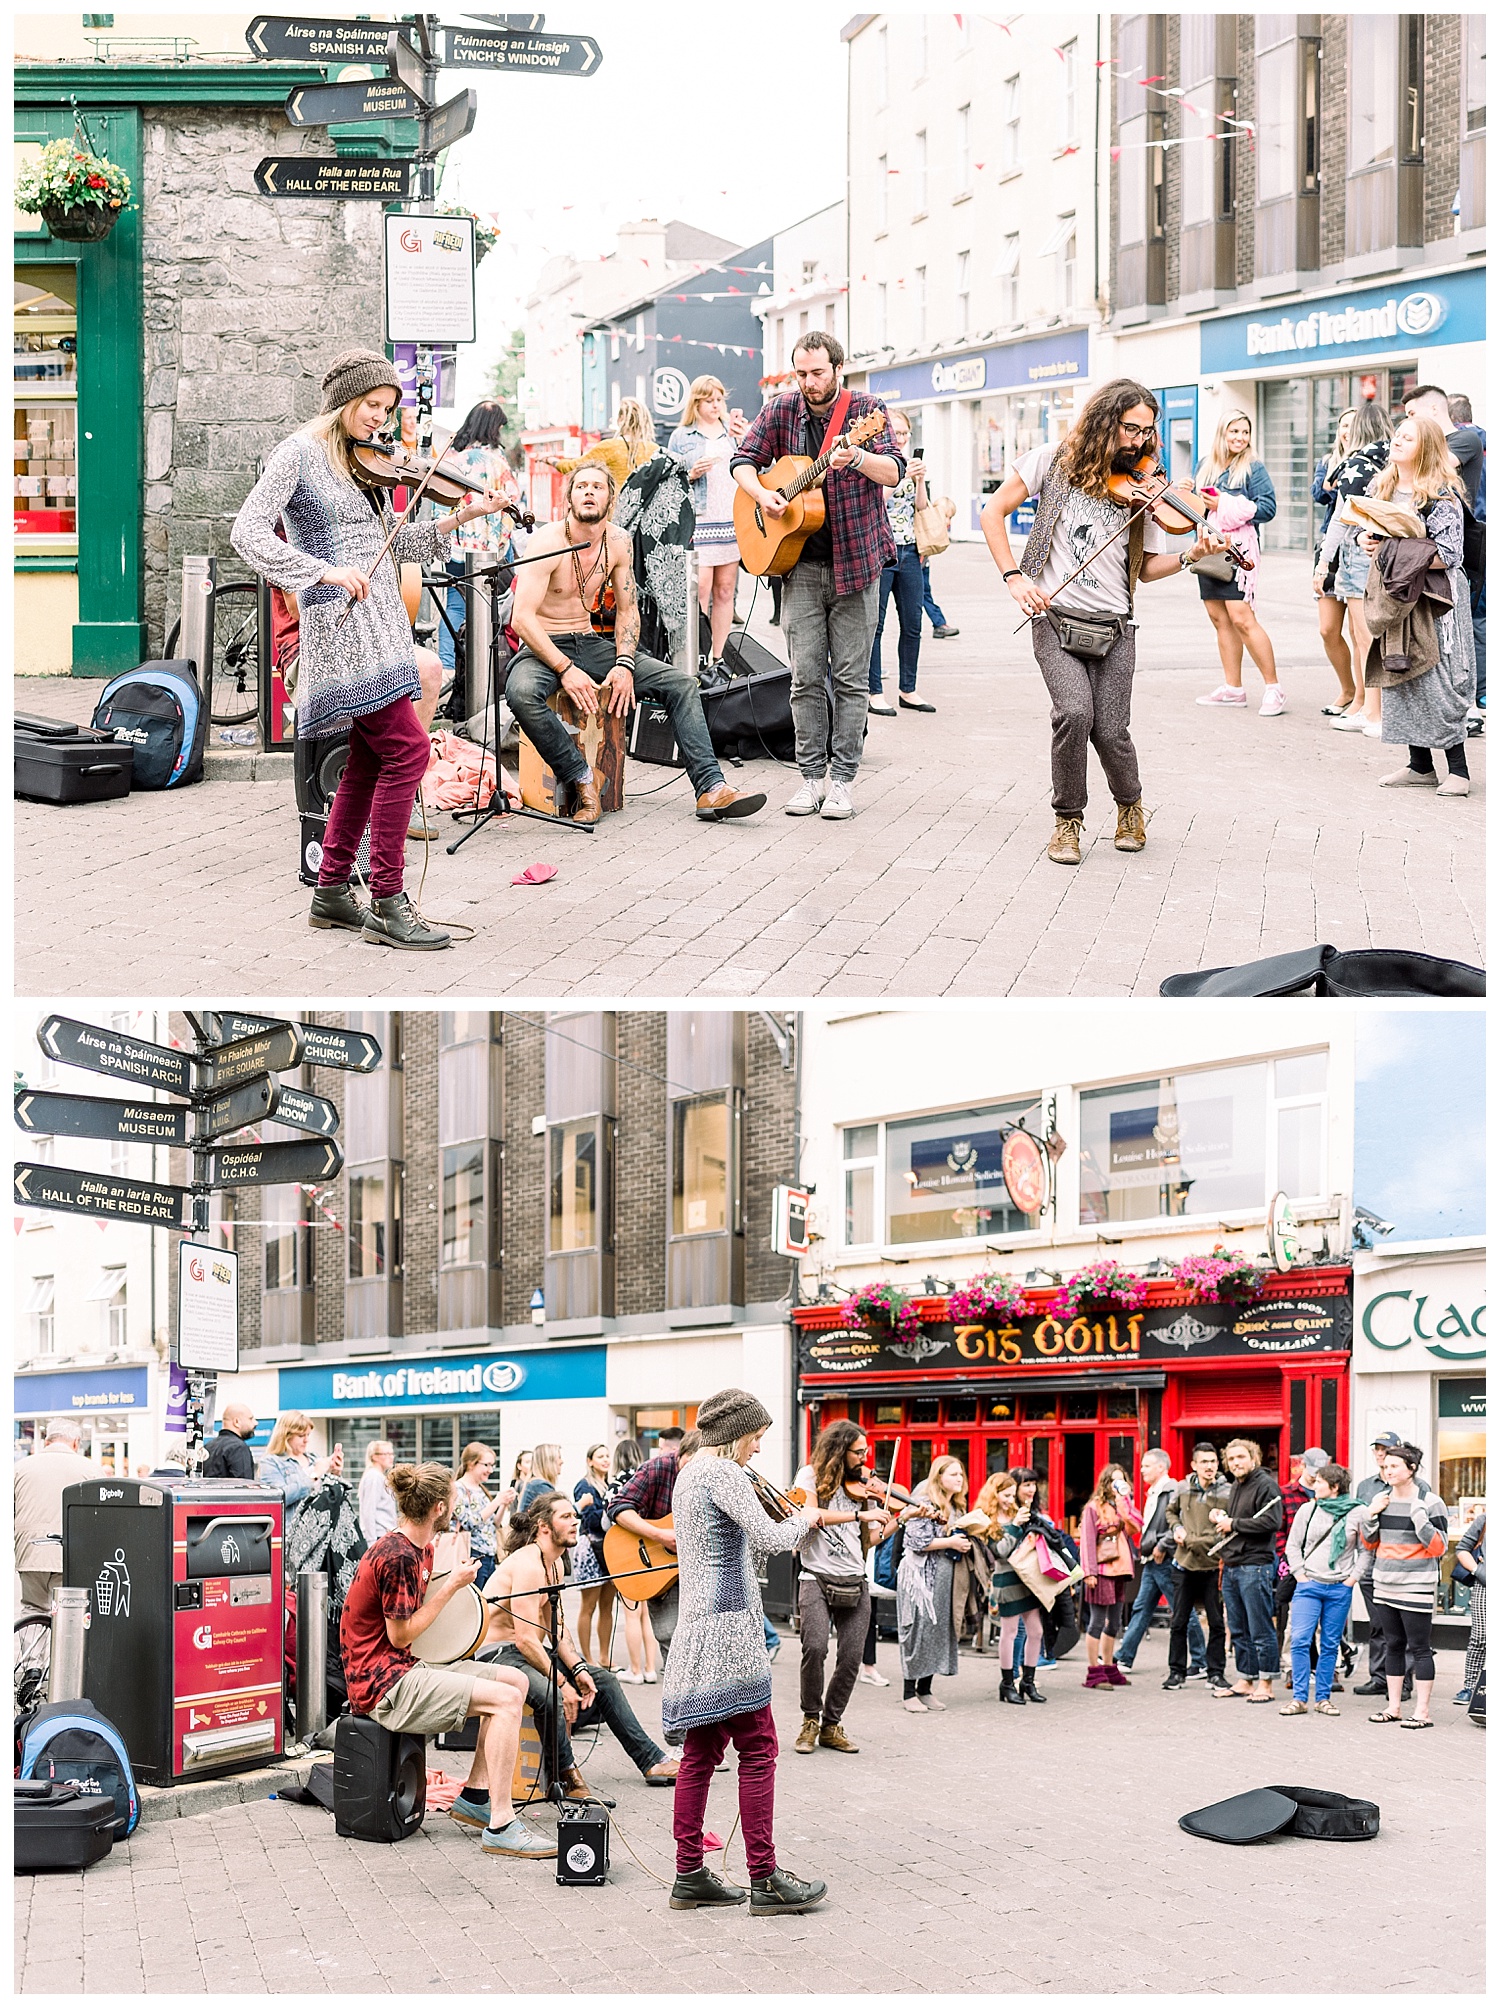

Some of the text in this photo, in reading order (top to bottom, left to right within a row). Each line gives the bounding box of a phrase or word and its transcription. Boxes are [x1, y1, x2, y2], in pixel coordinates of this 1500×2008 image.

[285, 24, 388, 41] Áirse na Spáinnea
[310, 42, 388, 54] SPANISH AR
[454, 35, 570, 54] Fuinneog an Linsigh
[454, 49, 560, 66] LYNCH'S WINDOW
[363, 99, 406, 112] MUSEUM
[319, 167, 342, 177] Halla
[359, 167, 380, 177] Iarla
[382, 168, 401, 178] Rua
[286, 180, 401, 191] HALL OF THE RED EARL
[1247, 300, 1396, 355] Bank of Ireland
[304, 1032, 346, 1047] Nioclás
[78, 1031, 182, 1070] Áirse na Spáinneach
[218, 1040, 271, 1065] An Fhaiche Mhór
[305, 1045, 349, 1061] CHURCH
[100, 1054, 182, 1084] SPANISH ARCH
[217, 1056, 265, 1080] EYRE SQUARE
[282, 1094, 314, 1112] Linsigh
[124, 1108, 175, 1122] Músaem
[118, 1122, 175, 1137] MUSEUM
[222, 1152, 262, 1168] Ospidéal
[1114, 1151, 1143, 1163] Louise
[221, 1167, 259, 1179] U.C.H.G.
[914, 1178, 940, 1188] Louise
[941, 1172, 974, 1186] Howard
[80, 1180, 174, 1205] Halla an Iarla Rua
[42, 1189, 174, 1219] HALL OF THE RED EARL
[332, 1364, 482, 1399] Bank of Ireland
[72, 1392, 134, 1407] top brands for less
[1461, 1404, 1486, 1412] ww
